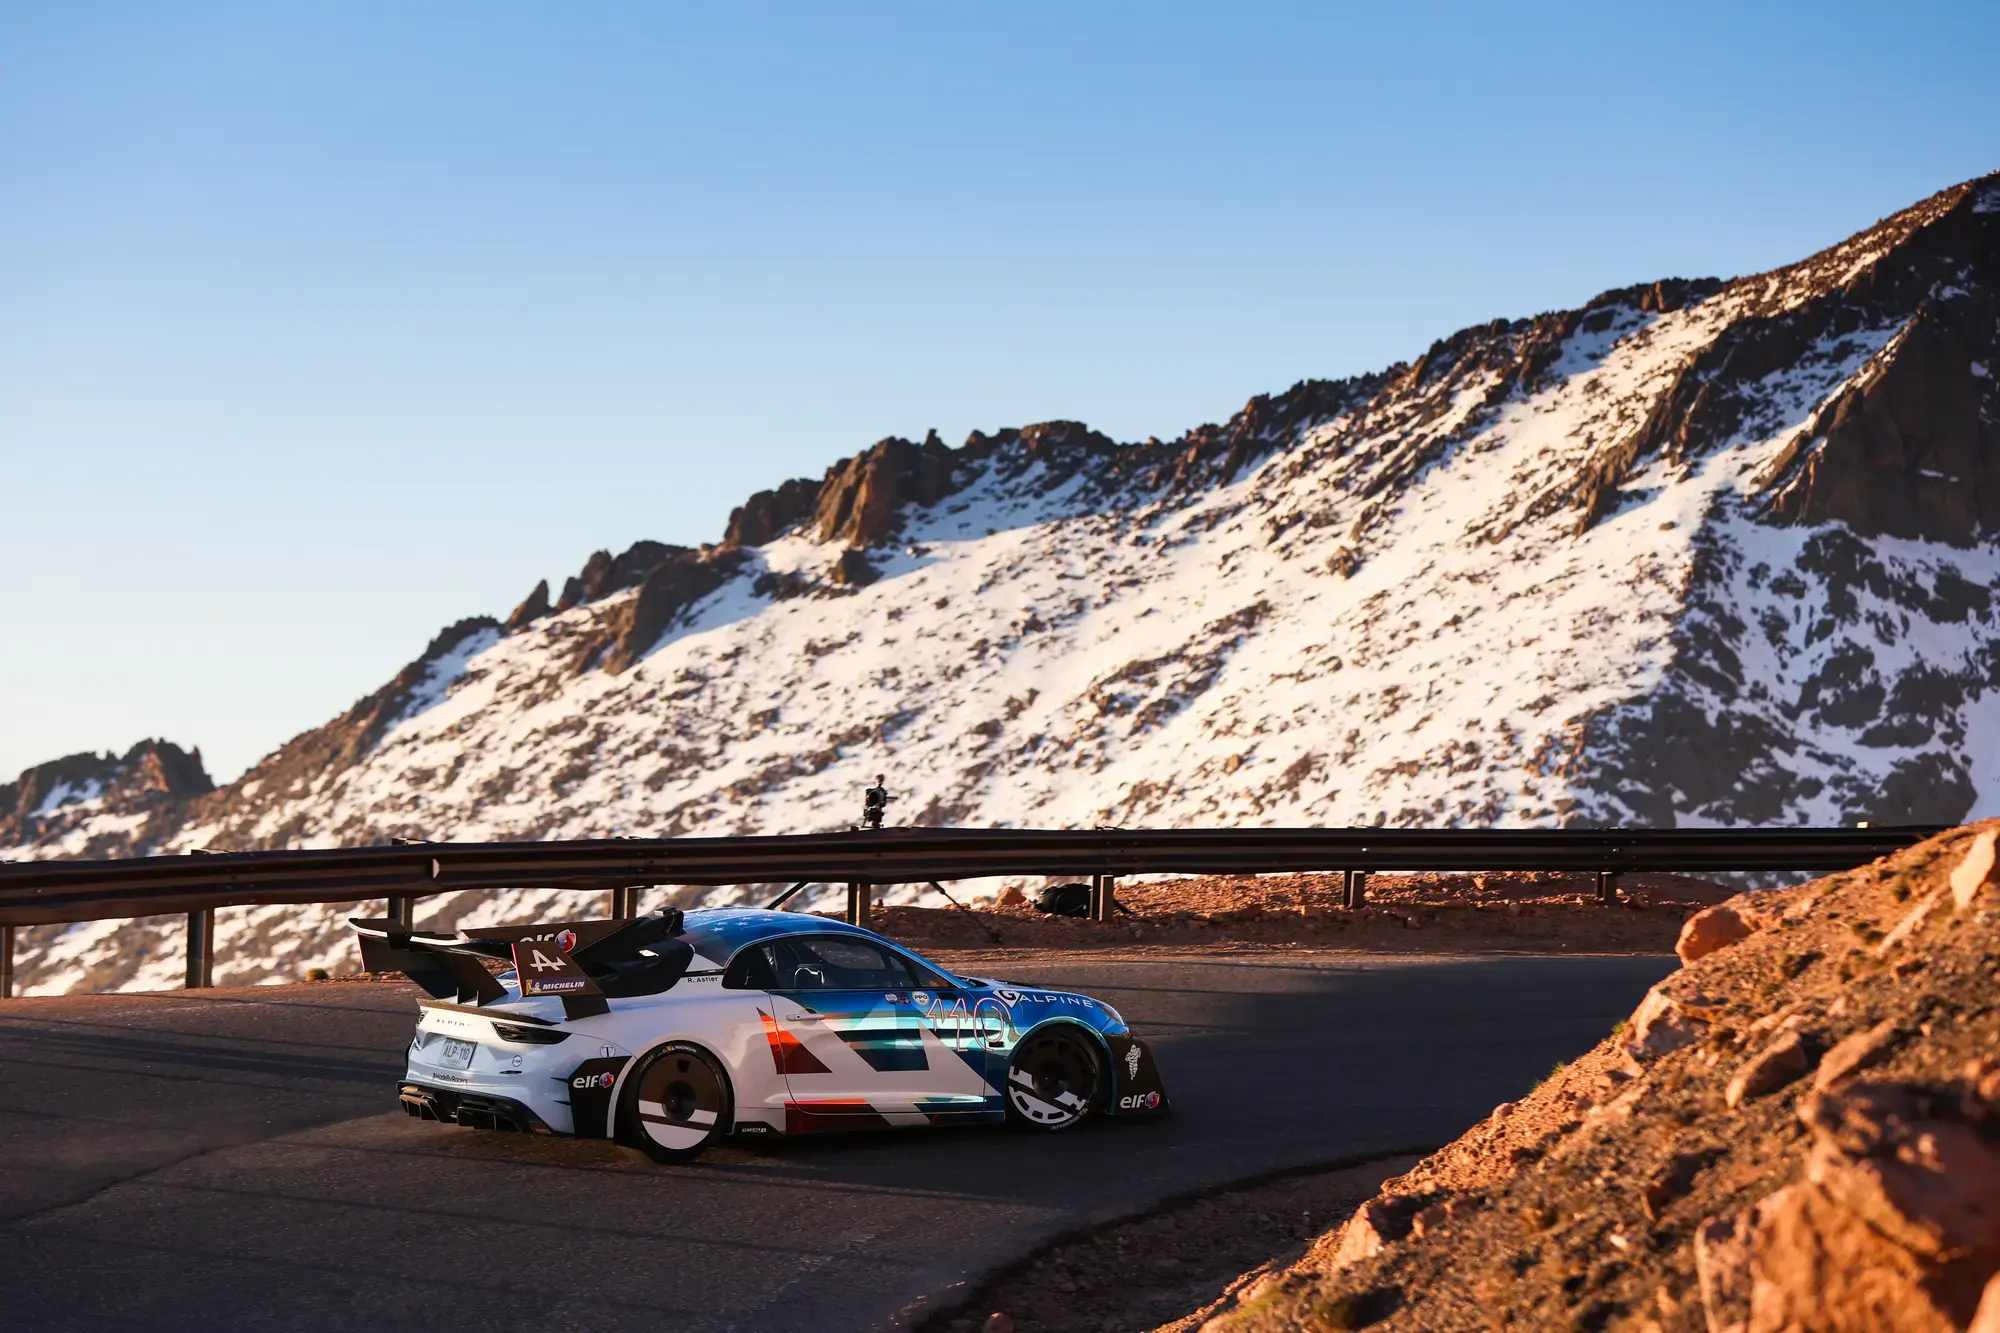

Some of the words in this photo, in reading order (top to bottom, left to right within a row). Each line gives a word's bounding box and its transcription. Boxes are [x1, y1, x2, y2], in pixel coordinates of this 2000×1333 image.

[542, 981, 585, 990] MICHELIN
[1020, 994, 1094, 1008] ALPINE
[925, 997, 1012, 1052] 110
[442, 1043, 471, 1061] ALP-110
[572, 1075, 599, 1089] elf
[1119, 1094, 1145, 1109] elf
